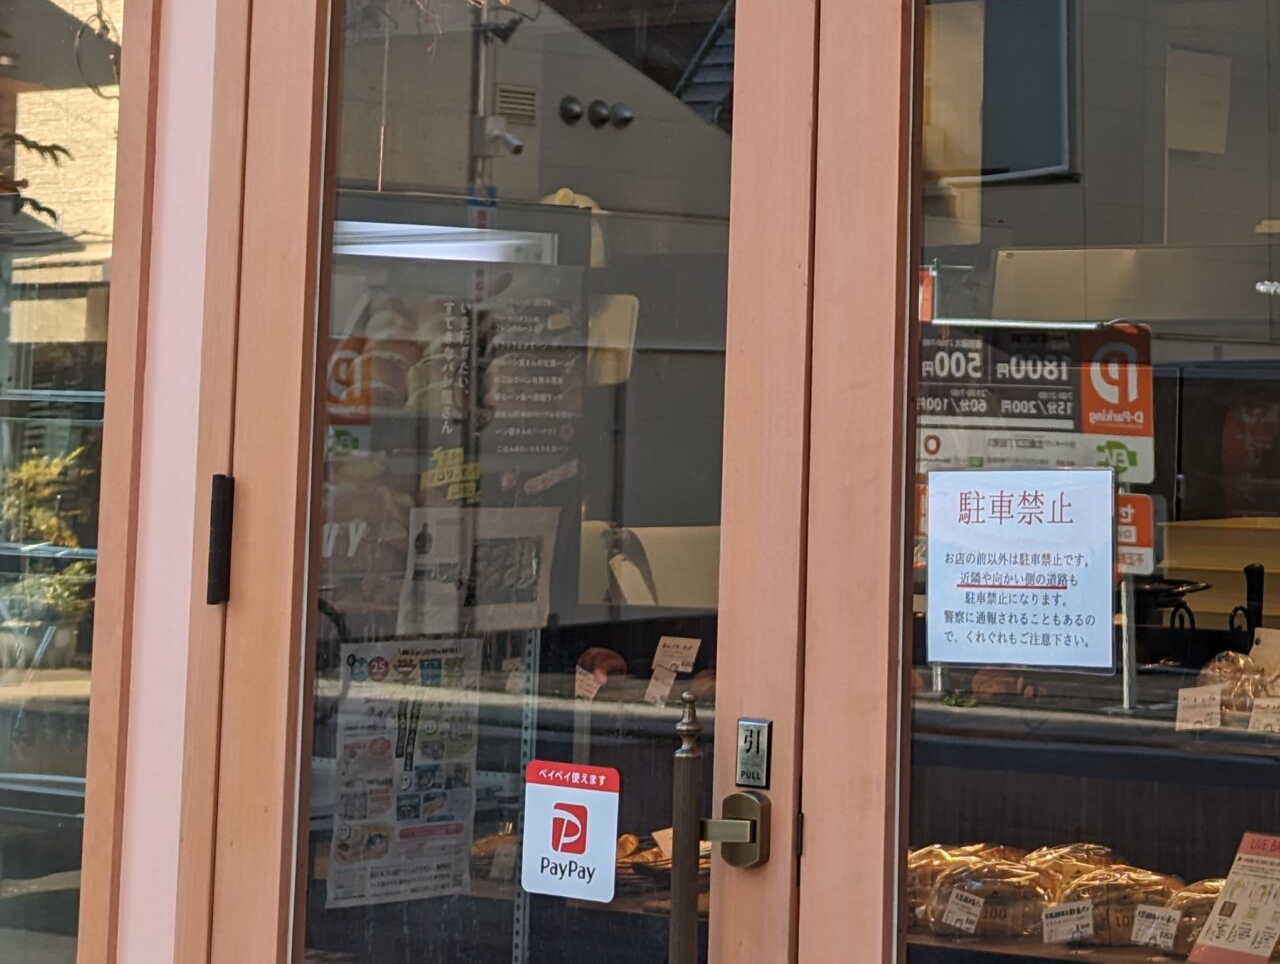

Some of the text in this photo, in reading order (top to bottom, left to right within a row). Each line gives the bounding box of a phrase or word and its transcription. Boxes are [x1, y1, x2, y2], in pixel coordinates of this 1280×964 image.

[958, 489, 1074, 526] 駐車禁止
[944, 552, 1089, 567] お店の前以外は駐車禁止です。
[960, 571, 1079, 586] 近隣や向かい側の道路も
[964, 591, 1067, 607] 駐車禁止になります。
[943, 609, 1096, 627] 警察に通報されることもあるの
[943, 630, 1089, 648] で、くれぐれもご注意下さい。
[743, 728, 761, 755] 引
[538, 768, 607, 786] ペイペイ使えます
[740, 770, 761, 781] PULL
[540, 856, 596, 885] PayPay
